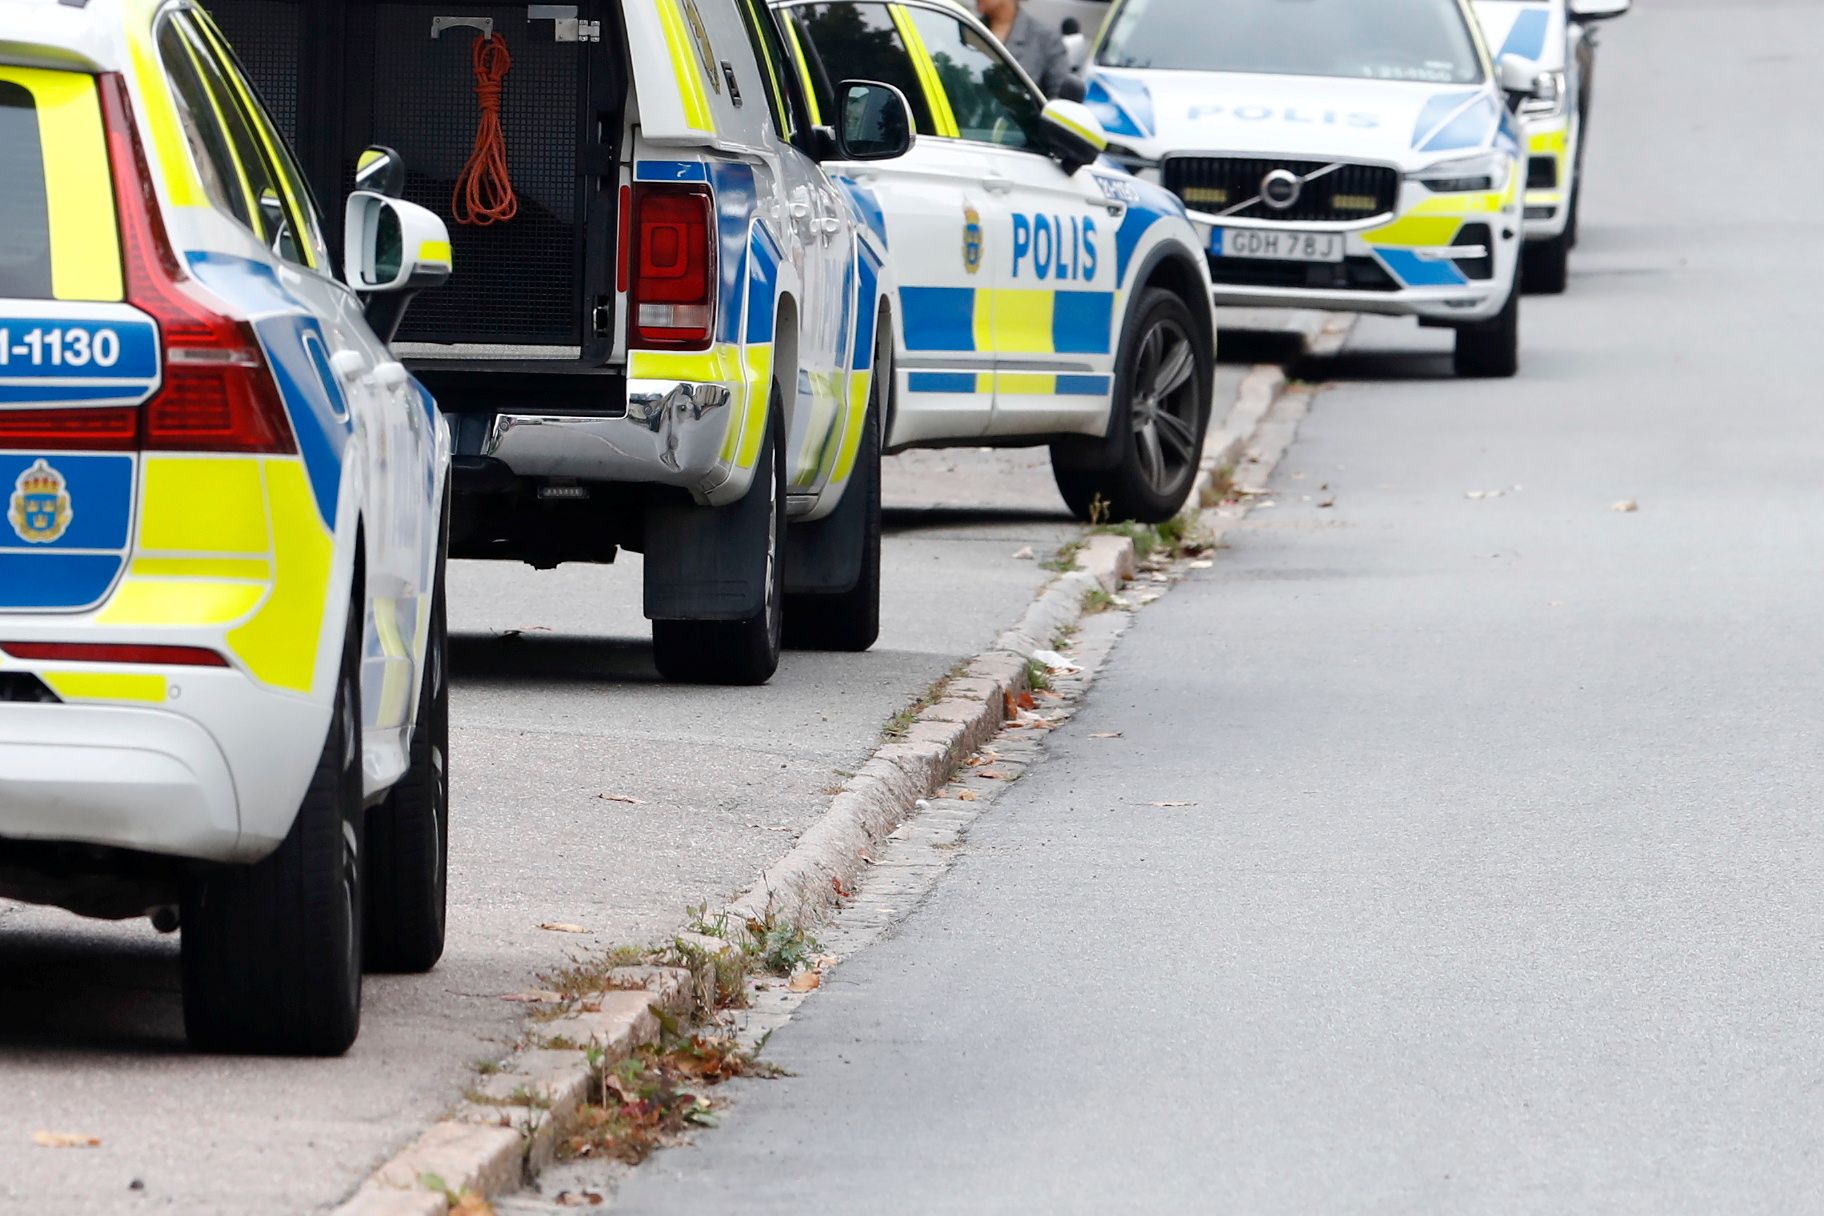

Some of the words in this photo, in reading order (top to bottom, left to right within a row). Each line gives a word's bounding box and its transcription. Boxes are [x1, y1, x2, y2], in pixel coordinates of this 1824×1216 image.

[1186, 105, 1379, 128] POLIS
[1011, 212, 1098, 282] POLIS
[1232, 230, 1279, 253] GDH
[1287, 234, 1333, 258] 78J
